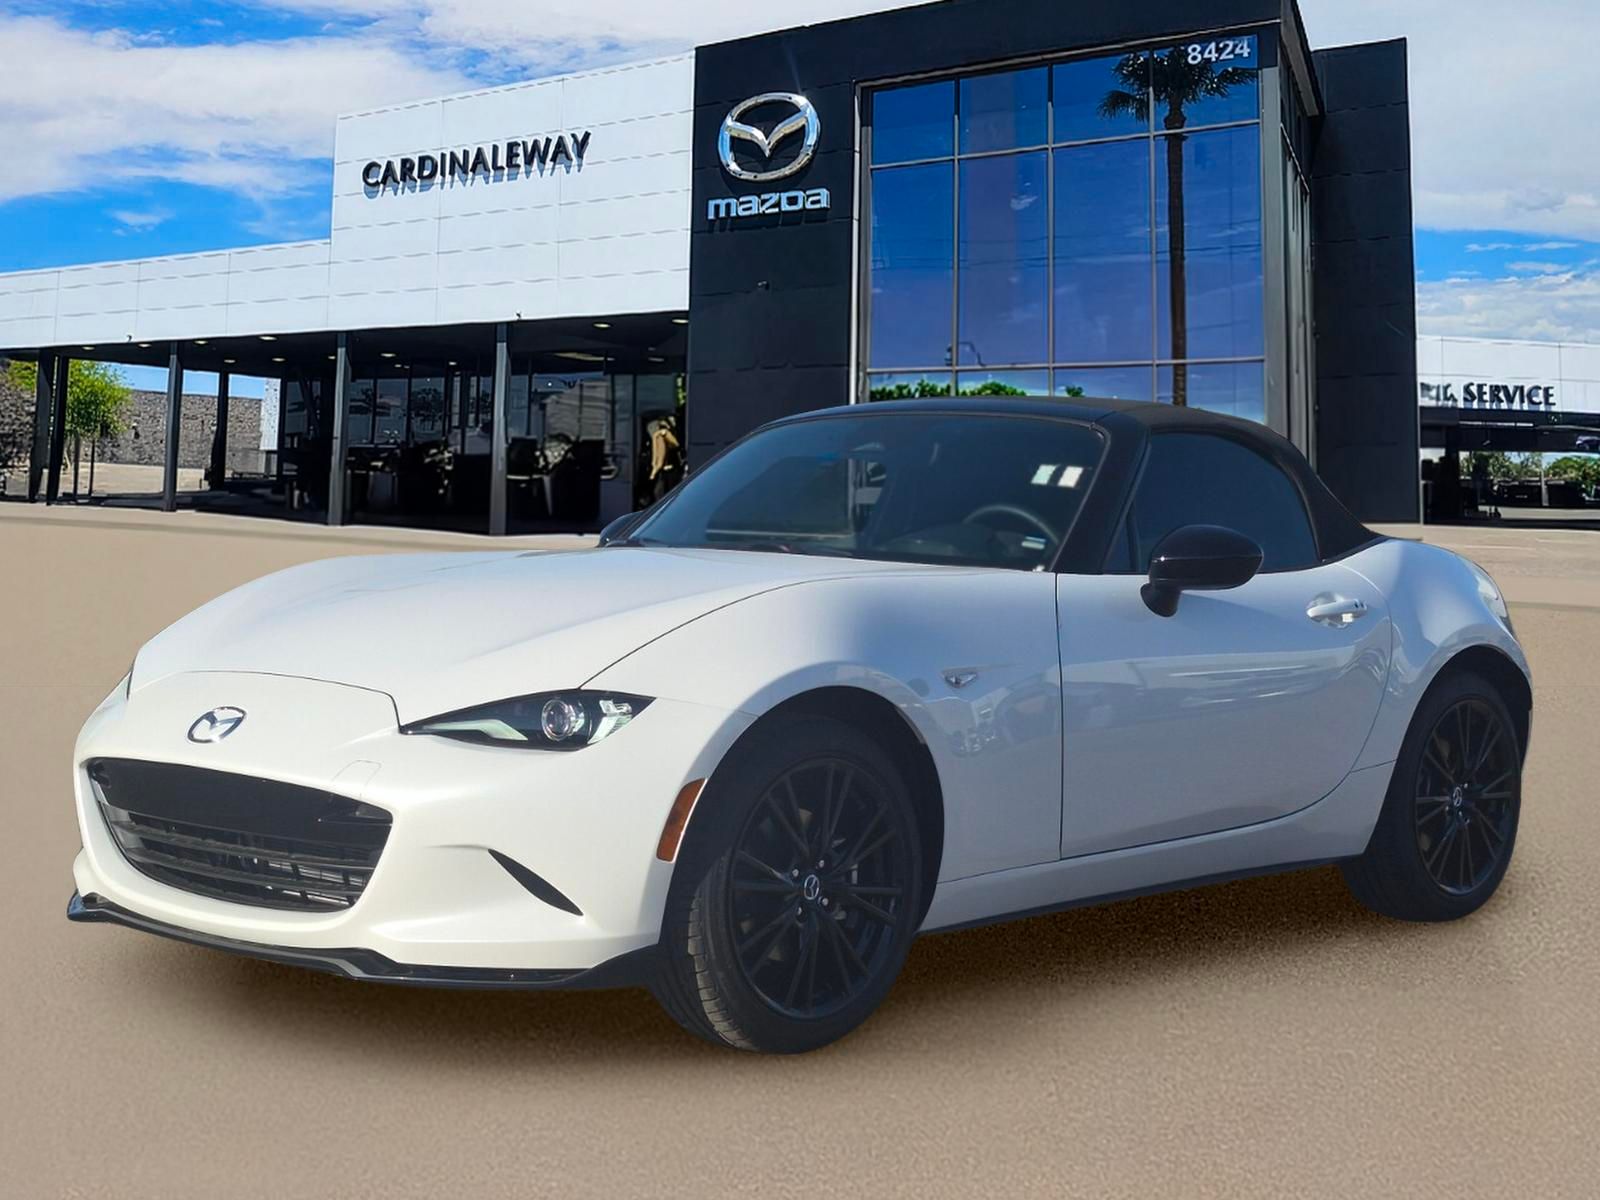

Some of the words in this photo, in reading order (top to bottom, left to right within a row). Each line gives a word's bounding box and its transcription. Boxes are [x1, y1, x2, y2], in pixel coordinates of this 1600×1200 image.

[1187, 38, 1251, 65] 8424
[362, 131, 592, 187] CARDINALEWAY
[1463, 382, 1556, 406] SERVICE
